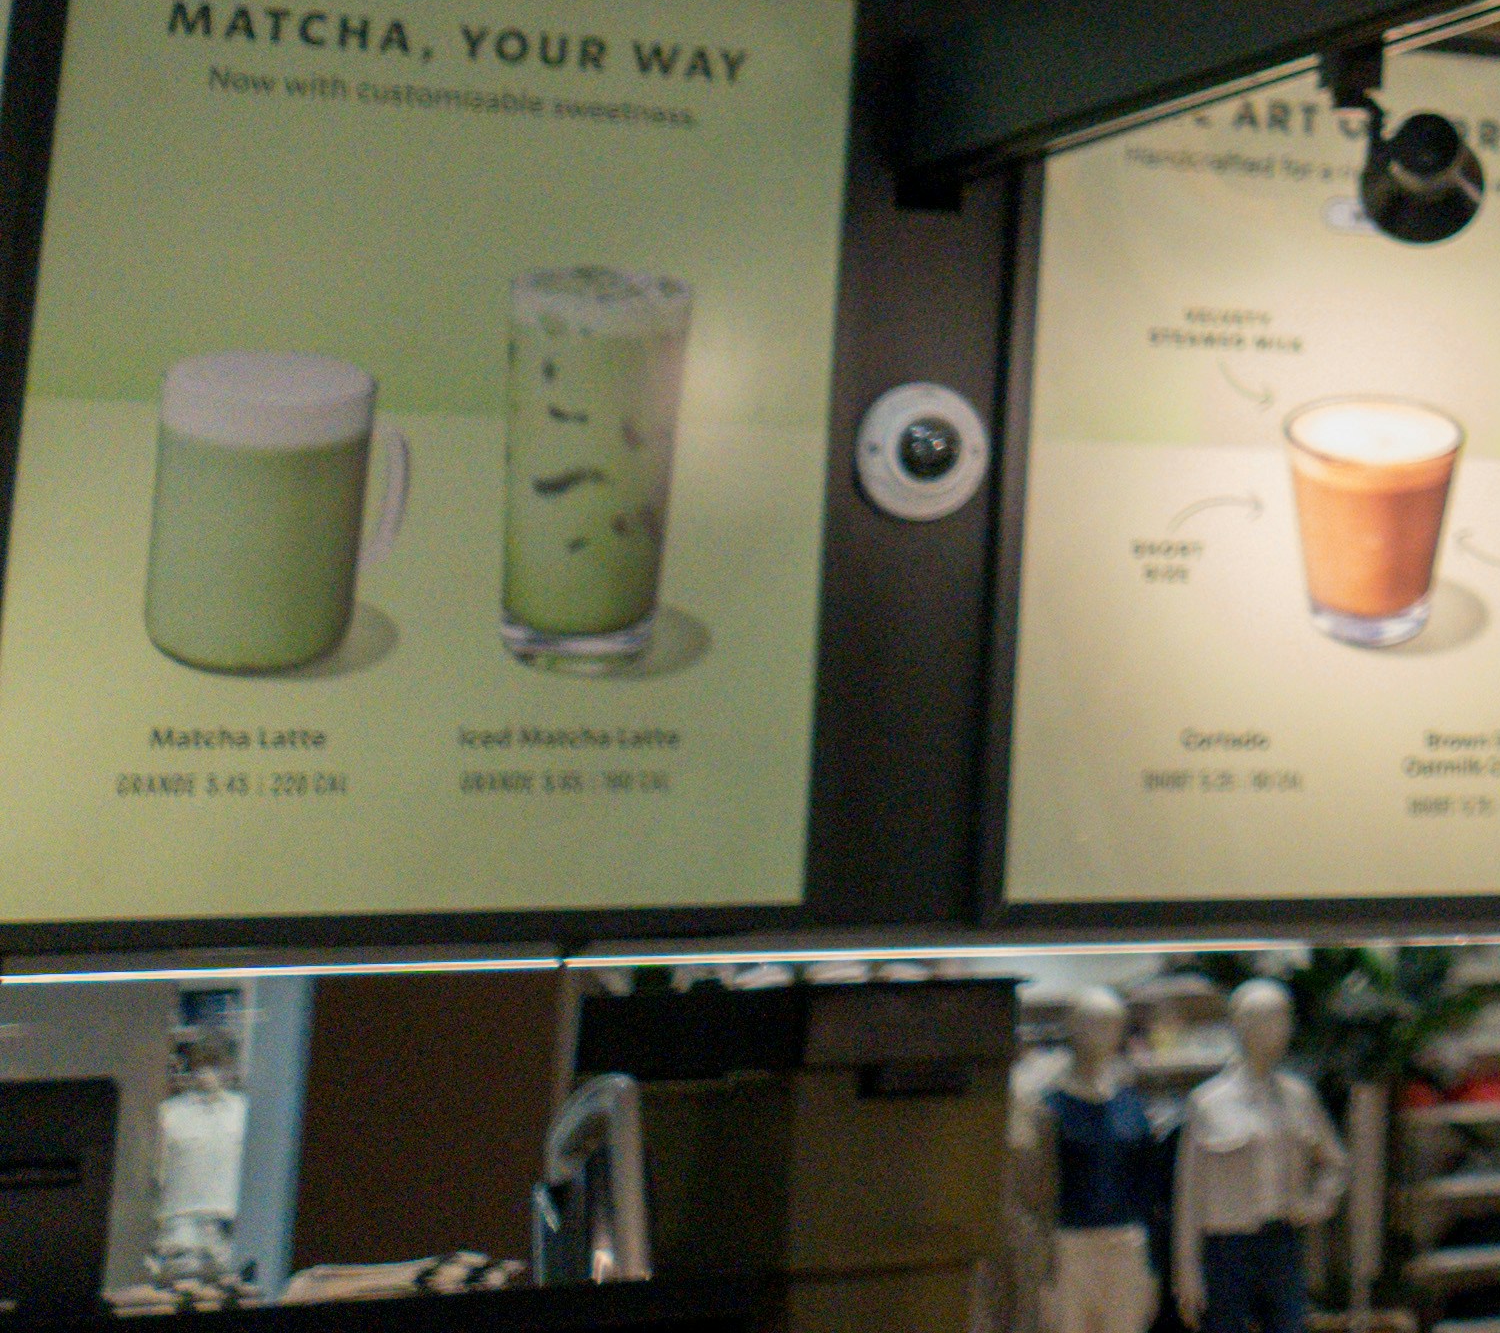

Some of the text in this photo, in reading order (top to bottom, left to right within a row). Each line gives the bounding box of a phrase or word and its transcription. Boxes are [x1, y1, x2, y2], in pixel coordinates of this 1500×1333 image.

[460, 23, 607, 73] YOUR
[632, 39, 748, 84] WAY
[209, 65, 275, 97] Now
[284, 73, 347, 102] with
[1234, 97, 1318, 135] ART
[150, 726, 328, 749] Matcha Latte
